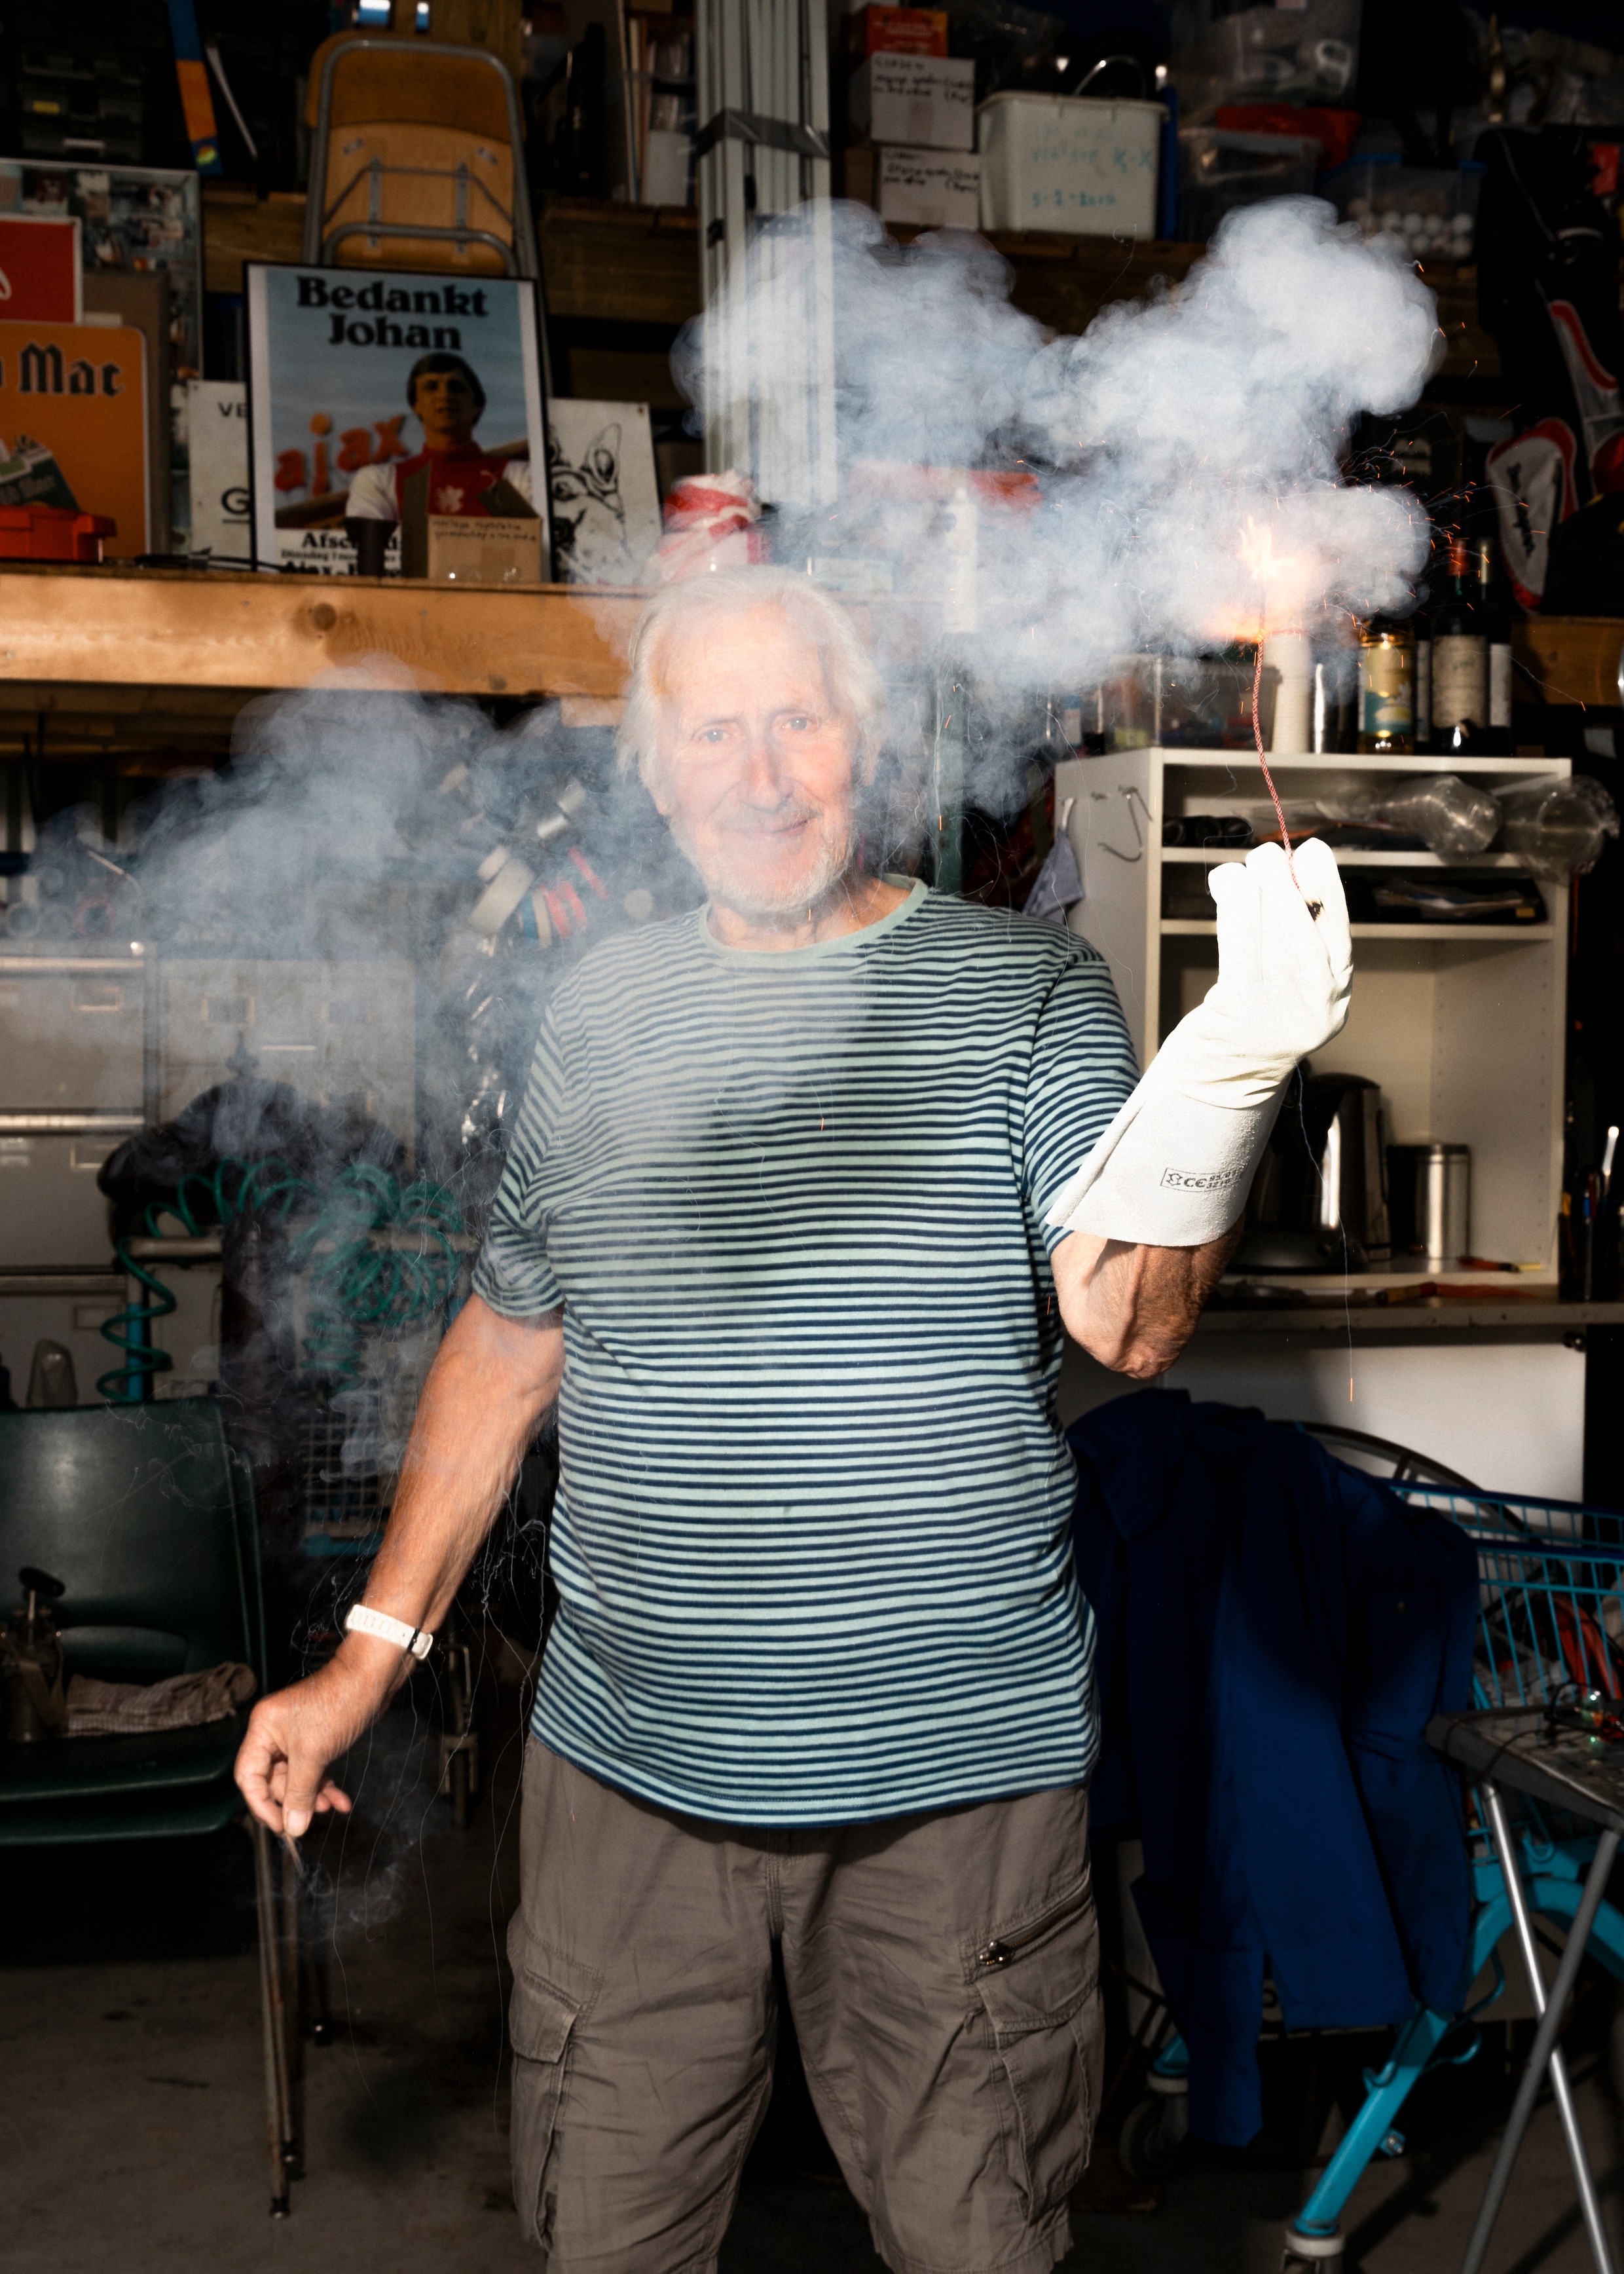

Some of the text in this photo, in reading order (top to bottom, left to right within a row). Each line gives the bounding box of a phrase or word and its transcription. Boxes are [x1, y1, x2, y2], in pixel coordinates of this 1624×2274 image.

[298, 276, 489, 317] Bedankt
[329, 314, 463, 351] Johan
[19, 339, 124, 396] Mac
[275, 413, 407, 498] ajax
[1184, 1178, 1207, 1187] CE
